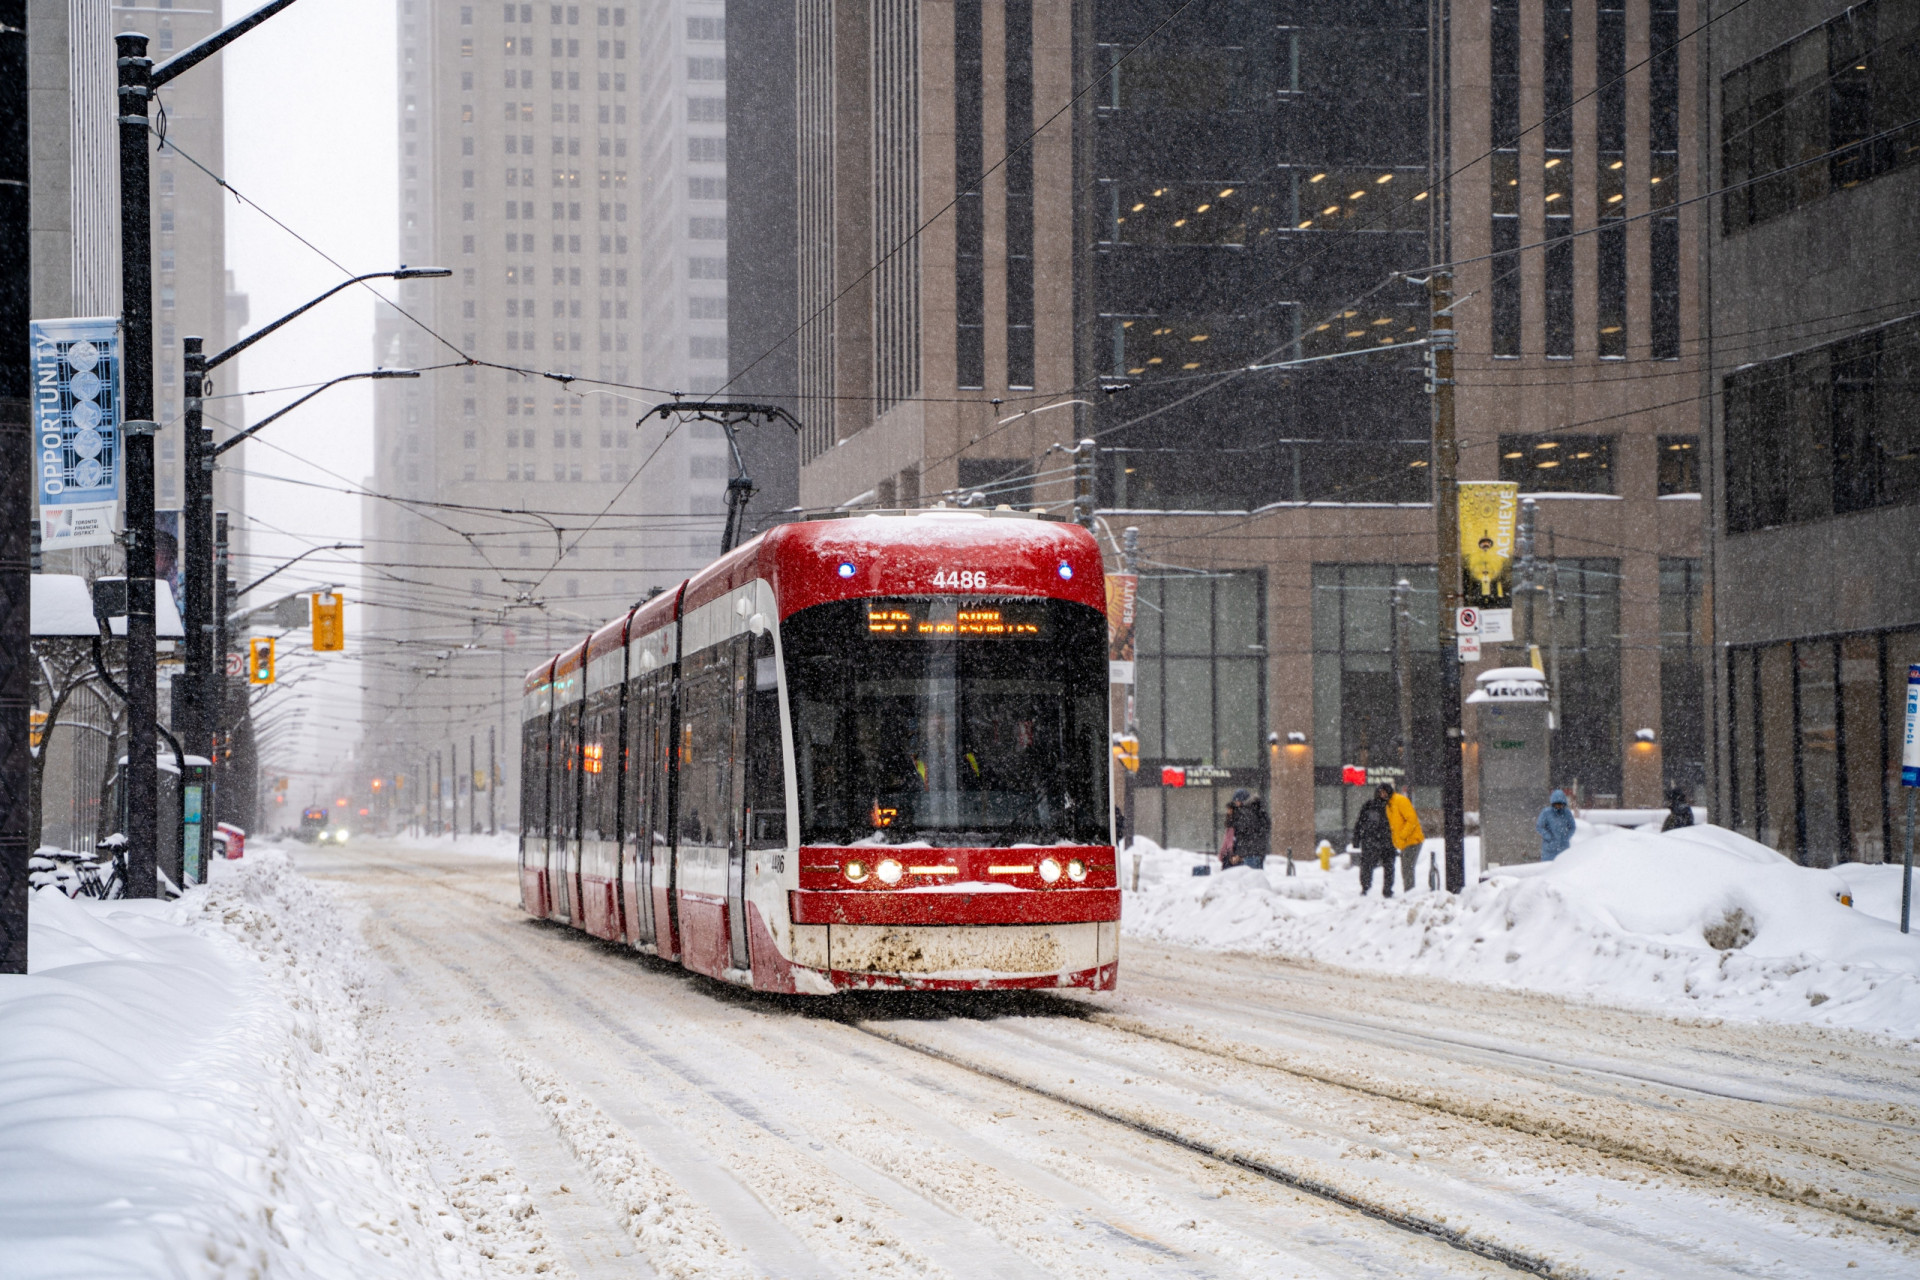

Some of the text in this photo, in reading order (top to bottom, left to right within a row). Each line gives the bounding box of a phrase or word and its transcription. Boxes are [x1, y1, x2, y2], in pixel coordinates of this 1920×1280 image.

[36, 333, 64, 495] OPPORTUNITY
[1496, 490, 1514, 559] ACHIEVE
[932, 570, 987, 589] 4486
[1123, 580, 1136, 624] BEAUTY
